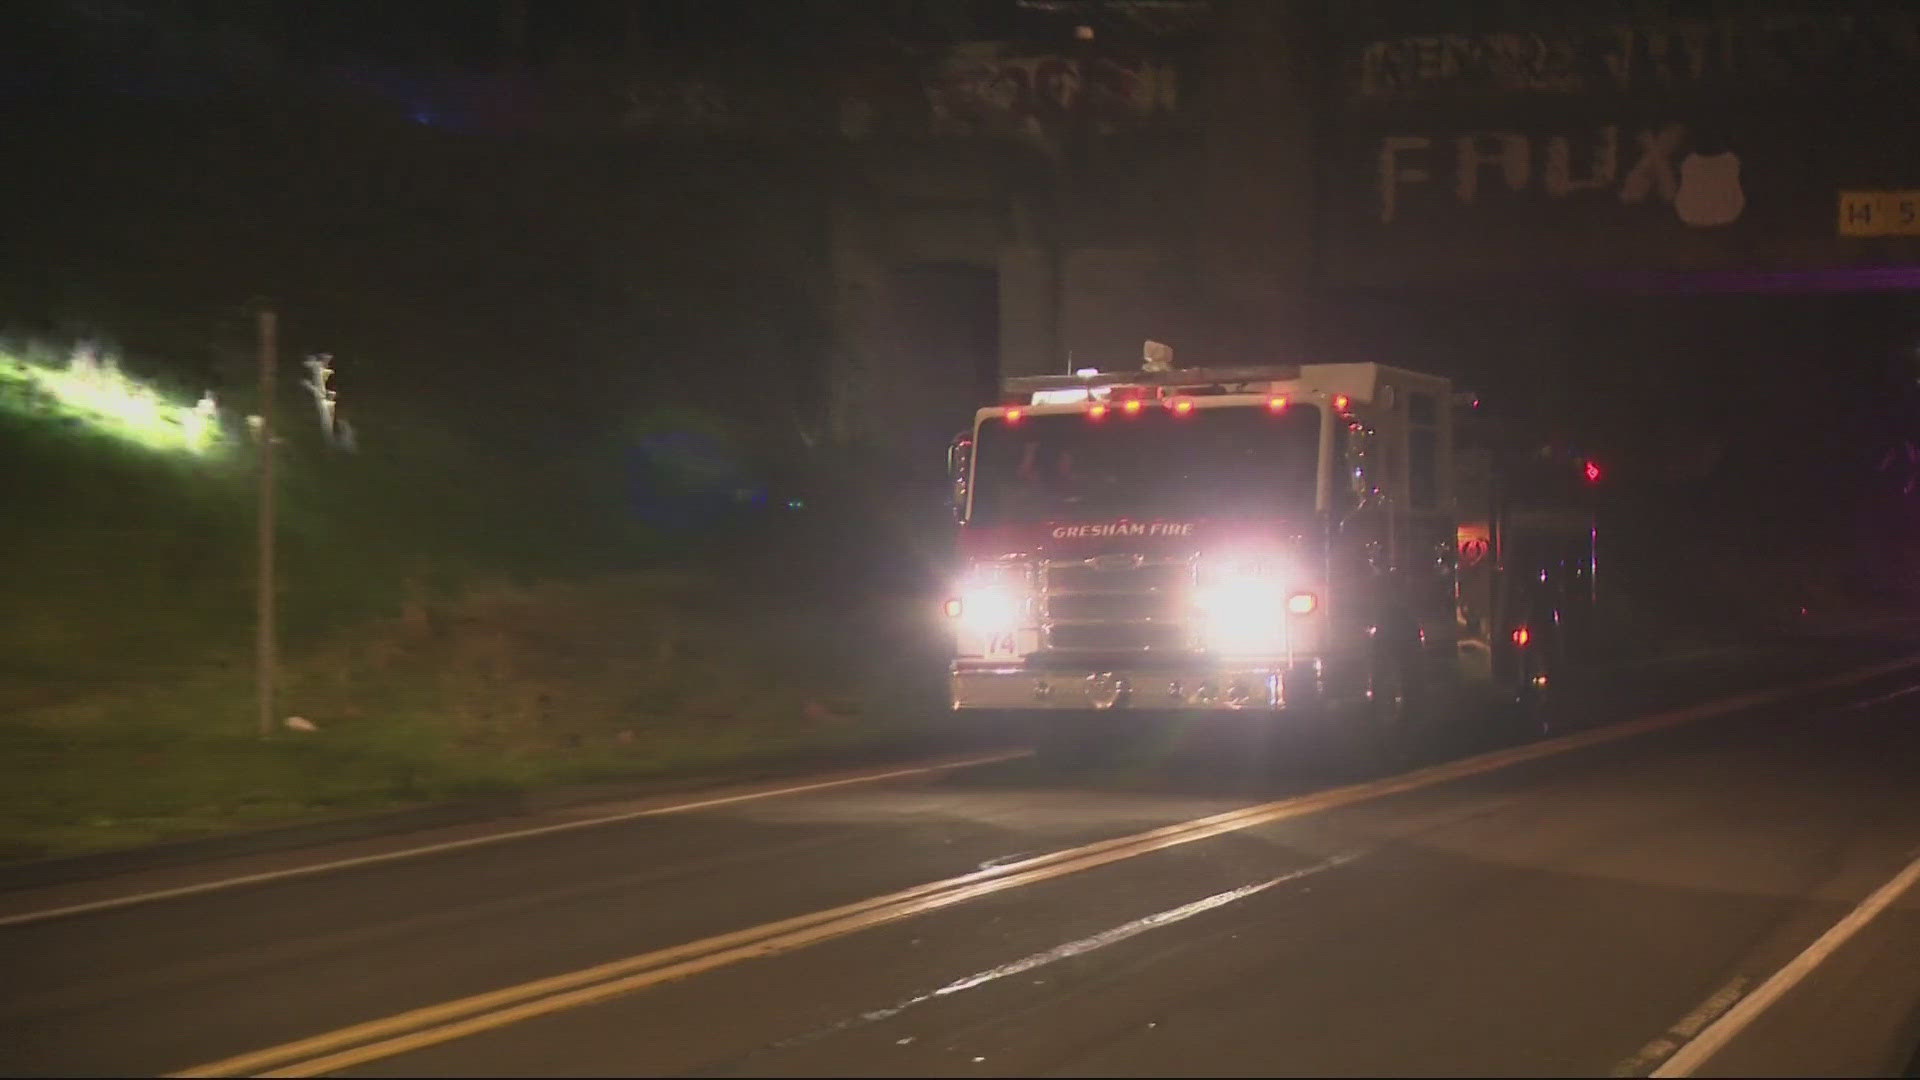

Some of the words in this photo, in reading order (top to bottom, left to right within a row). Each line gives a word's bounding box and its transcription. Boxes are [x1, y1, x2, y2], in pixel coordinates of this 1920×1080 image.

[1052, 522, 1146, 539] GRESHAM
[1150, 522, 1195, 537] FIRE
[985, 631, 1017, 654] 74
